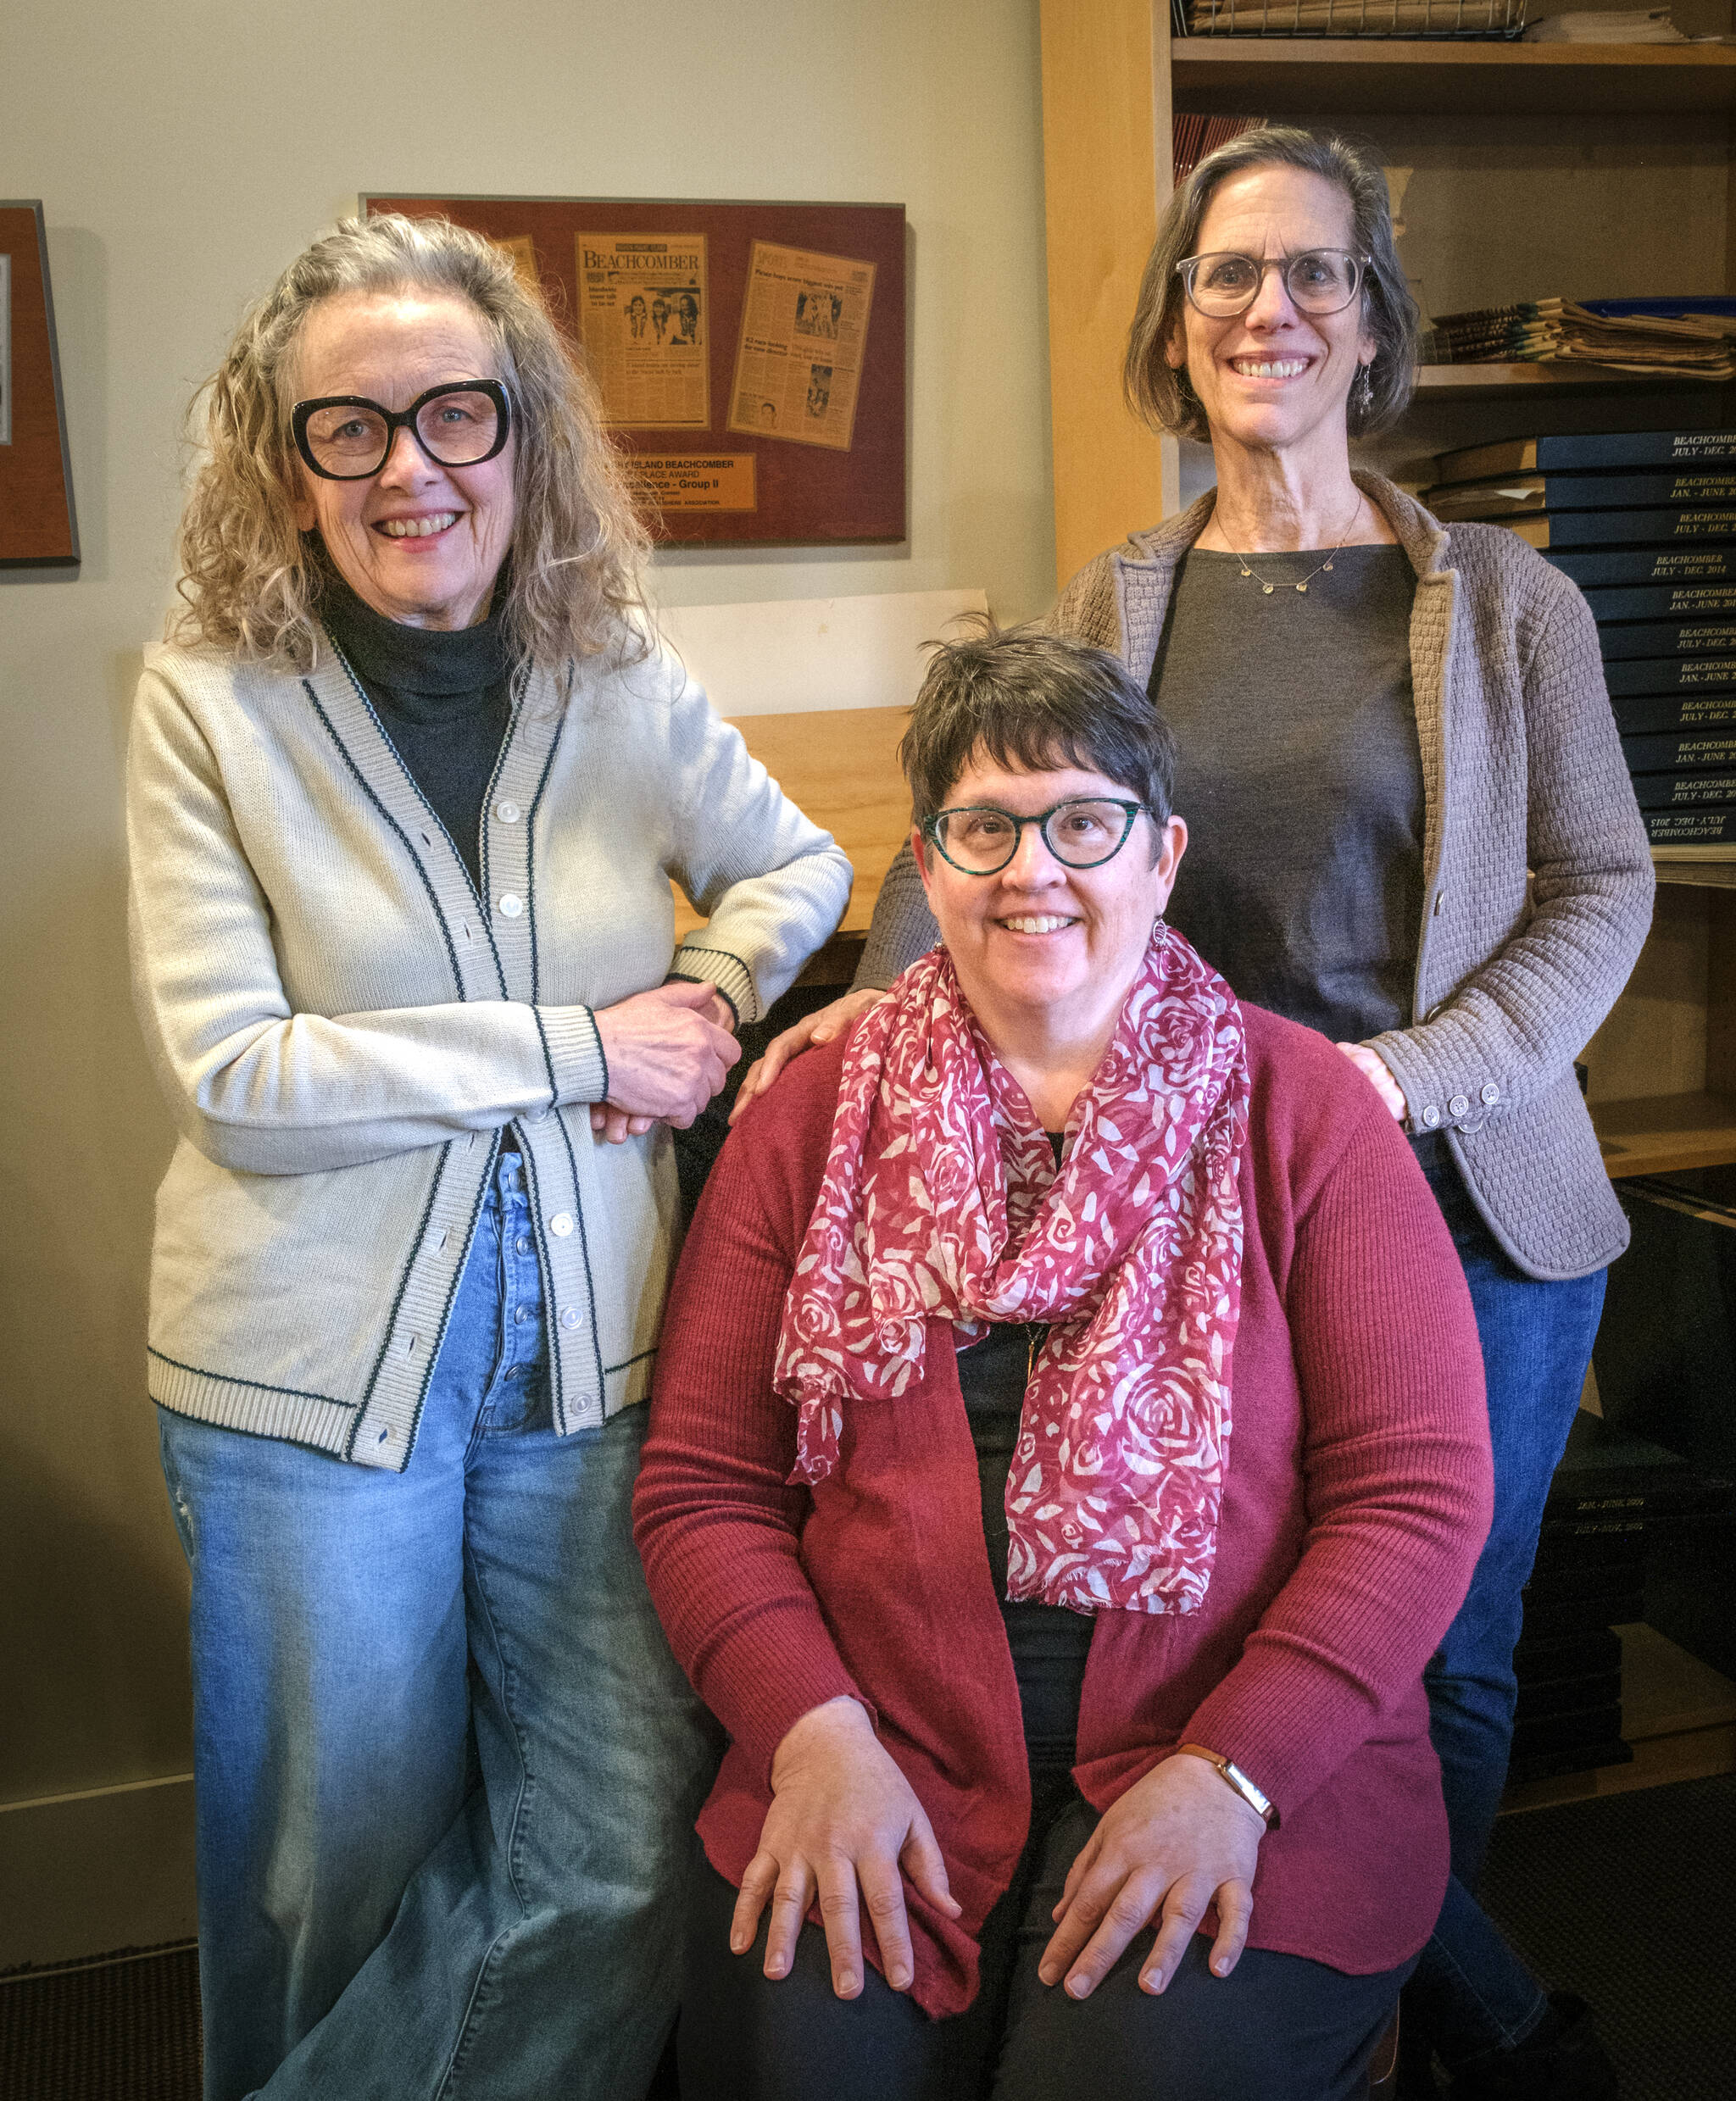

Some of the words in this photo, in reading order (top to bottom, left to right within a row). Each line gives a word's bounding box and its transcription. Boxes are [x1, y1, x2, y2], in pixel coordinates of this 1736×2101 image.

[582, 250, 699, 270] BEACHCOMBER
[665, 459, 734, 469] BEACHCOMBER
[679, 480, 710, 490] Group
[1655, 554, 1722, 565] BEACHCOMBER
[1651, 567, 1676, 576] JULY
[1650, 826, 1723, 837] BEACHCOMBER
